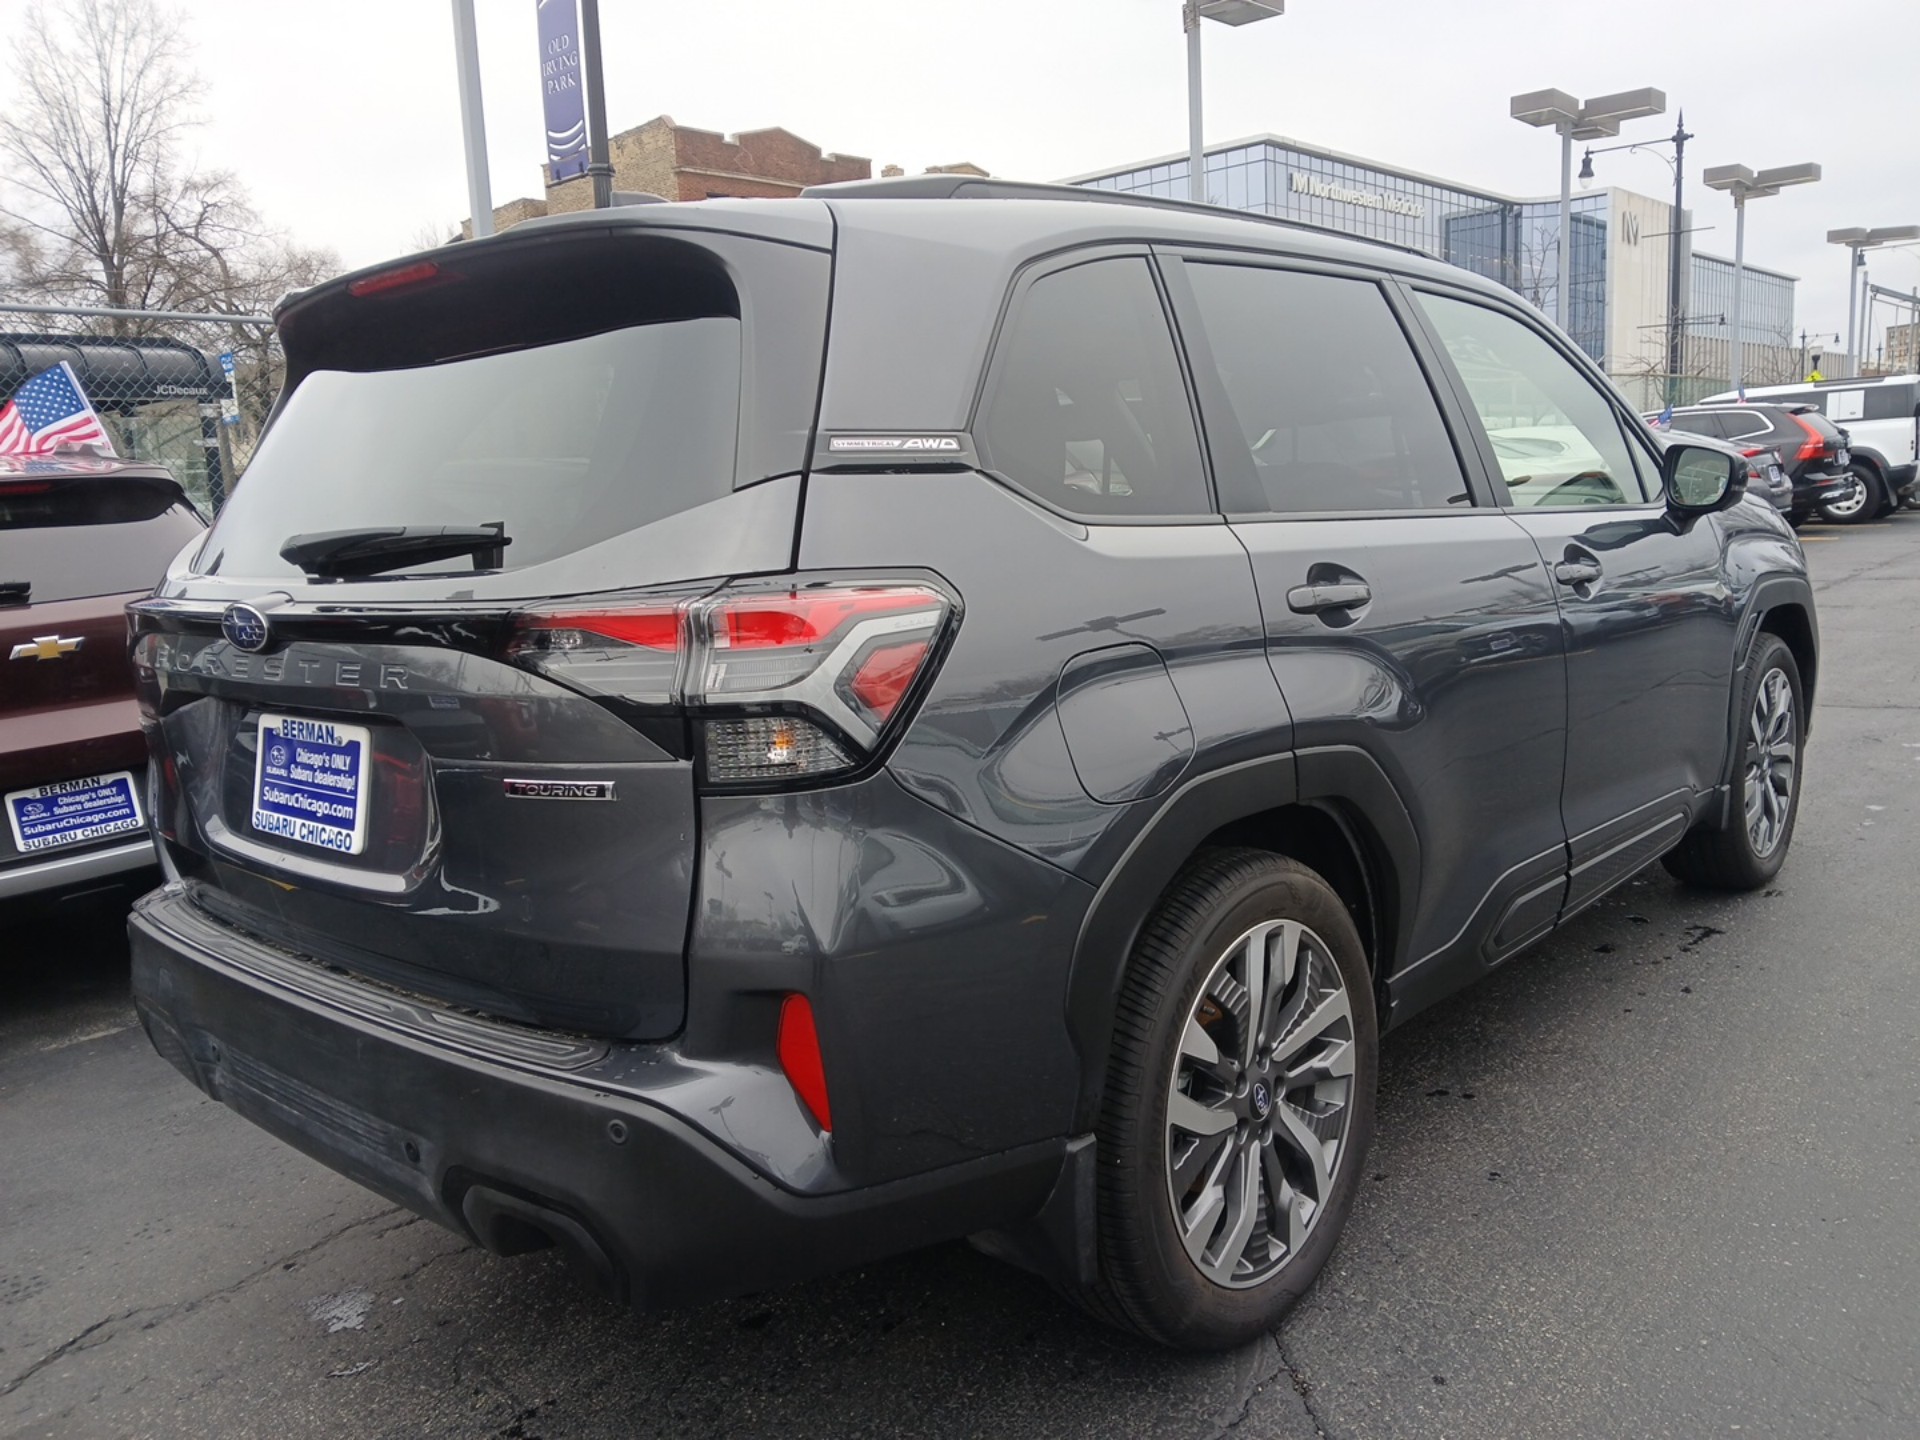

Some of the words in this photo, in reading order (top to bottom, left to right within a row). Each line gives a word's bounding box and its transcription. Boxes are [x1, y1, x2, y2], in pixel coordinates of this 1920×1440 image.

[548, 34, 569, 54] OLD
[543, 51, 578, 76] IRVING
[547, 72, 576, 94] PARK
[1309, 175, 1384, 209] Northwestern
[154, 384, 208, 396] JCDecaux
[834, 440, 896, 448] SYMMETRICAL
[902, 438, 958, 449] AWD
[155, 645, 409, 690] FORESTER
[282, 718, 335, 744] BERMAN
[266, 765, 288, 777] SUBARU
[296, 747, 330, 769] Chicago's
[331, 753, 352, 771] ONLY
[38, 776, 101, 797] BERMAN
[290, 764, 313, 780] Subaru
[314, 770, 356, 792] dealership!
[514, 783, 598, 797] TOURING
[53, 803, 82, 816] Subaru
[83, 794, 126, 810] dealership!
[58, 791, 97, 805] Chicago's
[97, 786, 117, 798] ONLY
[263, 786, 353, 819] SubaruChicago.com
[23, 806, 130, 836] SubaruChicago.com
[254, 811, 297, 837] SUBARU
[299, 822, 352, 851] CHICAGO
[23, 830, 78, 851] SUBARU
[81, 818, 139, 838] CHICAGO
